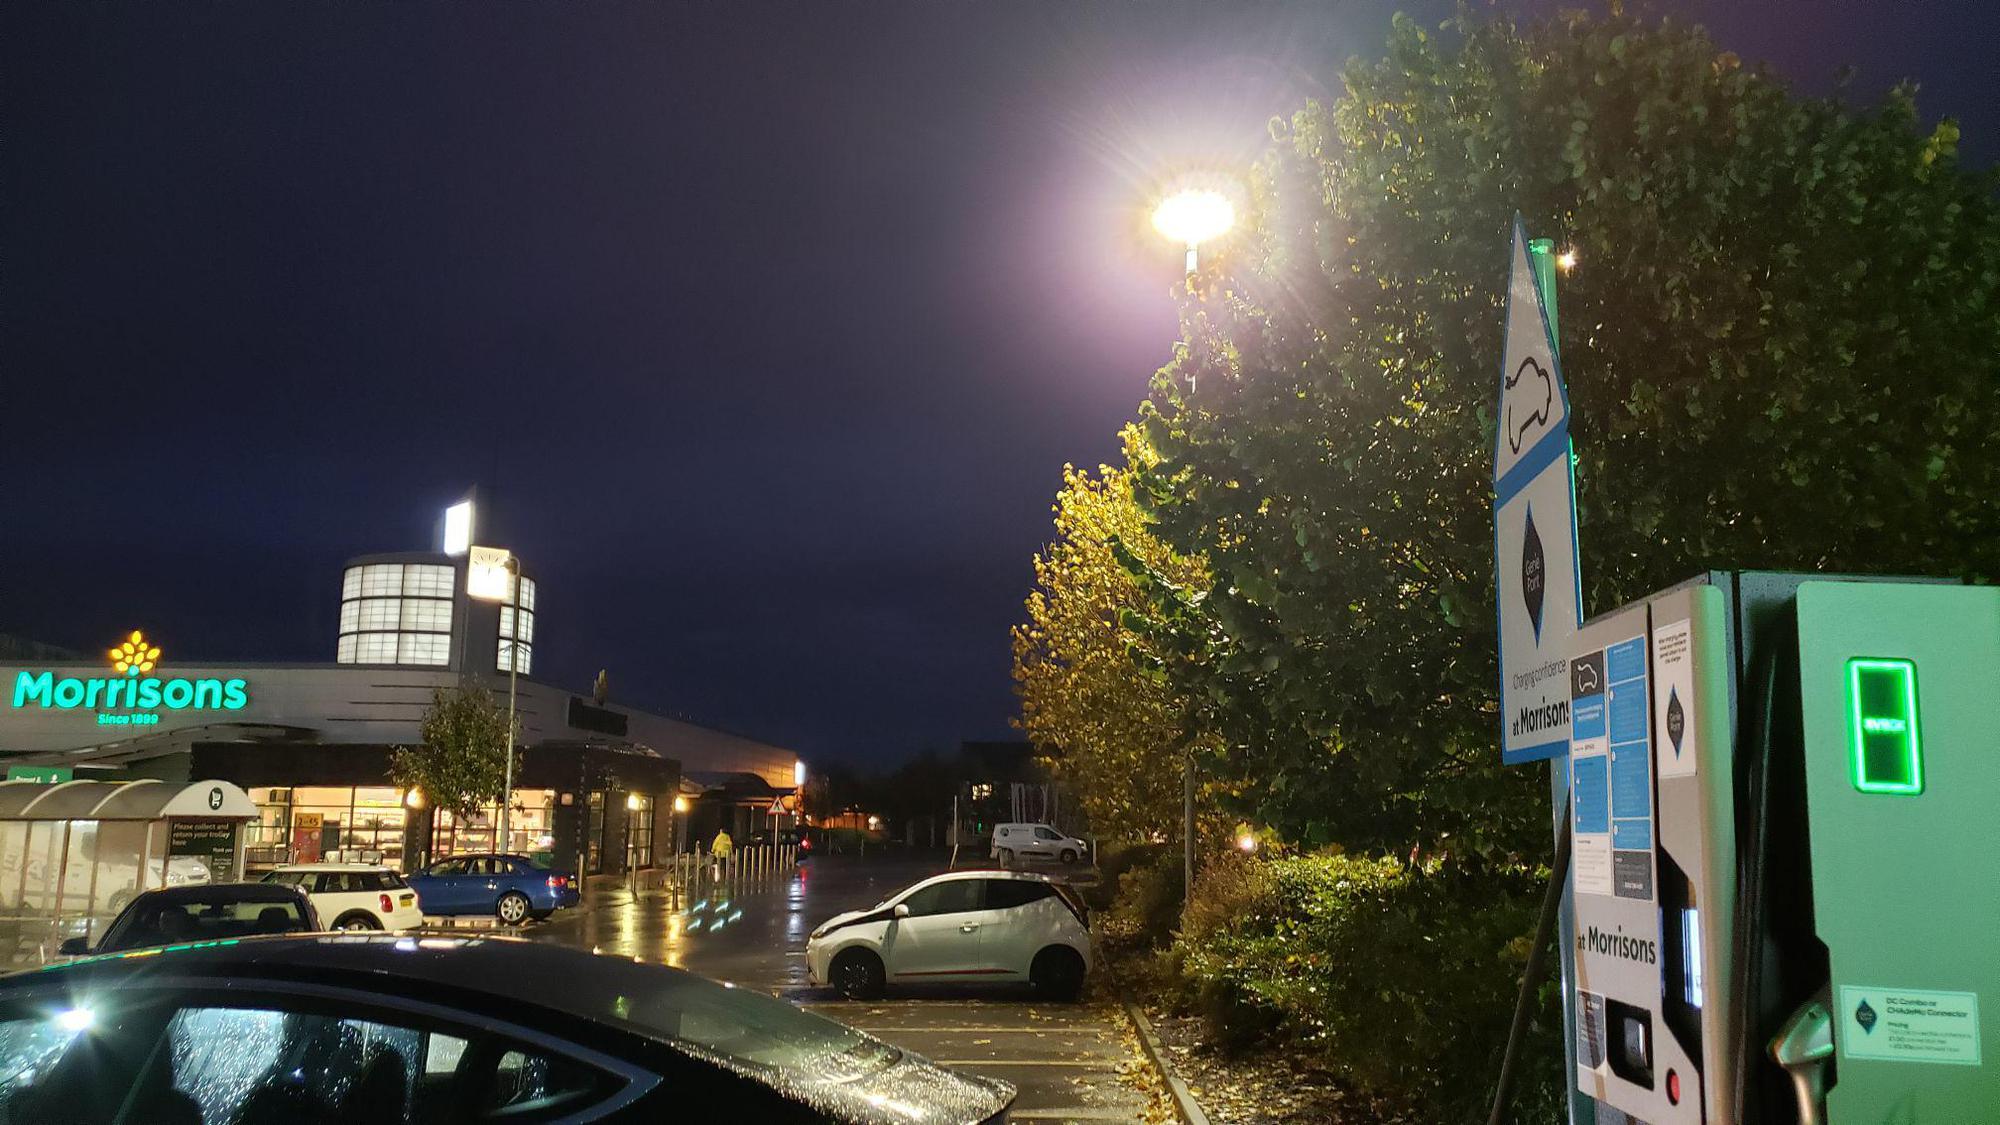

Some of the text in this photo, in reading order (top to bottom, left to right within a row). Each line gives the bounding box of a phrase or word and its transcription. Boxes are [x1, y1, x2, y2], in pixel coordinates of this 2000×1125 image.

[12, 668, 248, 709] Morrisons
[1513, 660, 1566, 690] Charging confidence
[97, 713, 159, 725] Since 1899
[1513, 719, 1520, 736] at
[1577, 925, 1656, 965] at Morrisons
